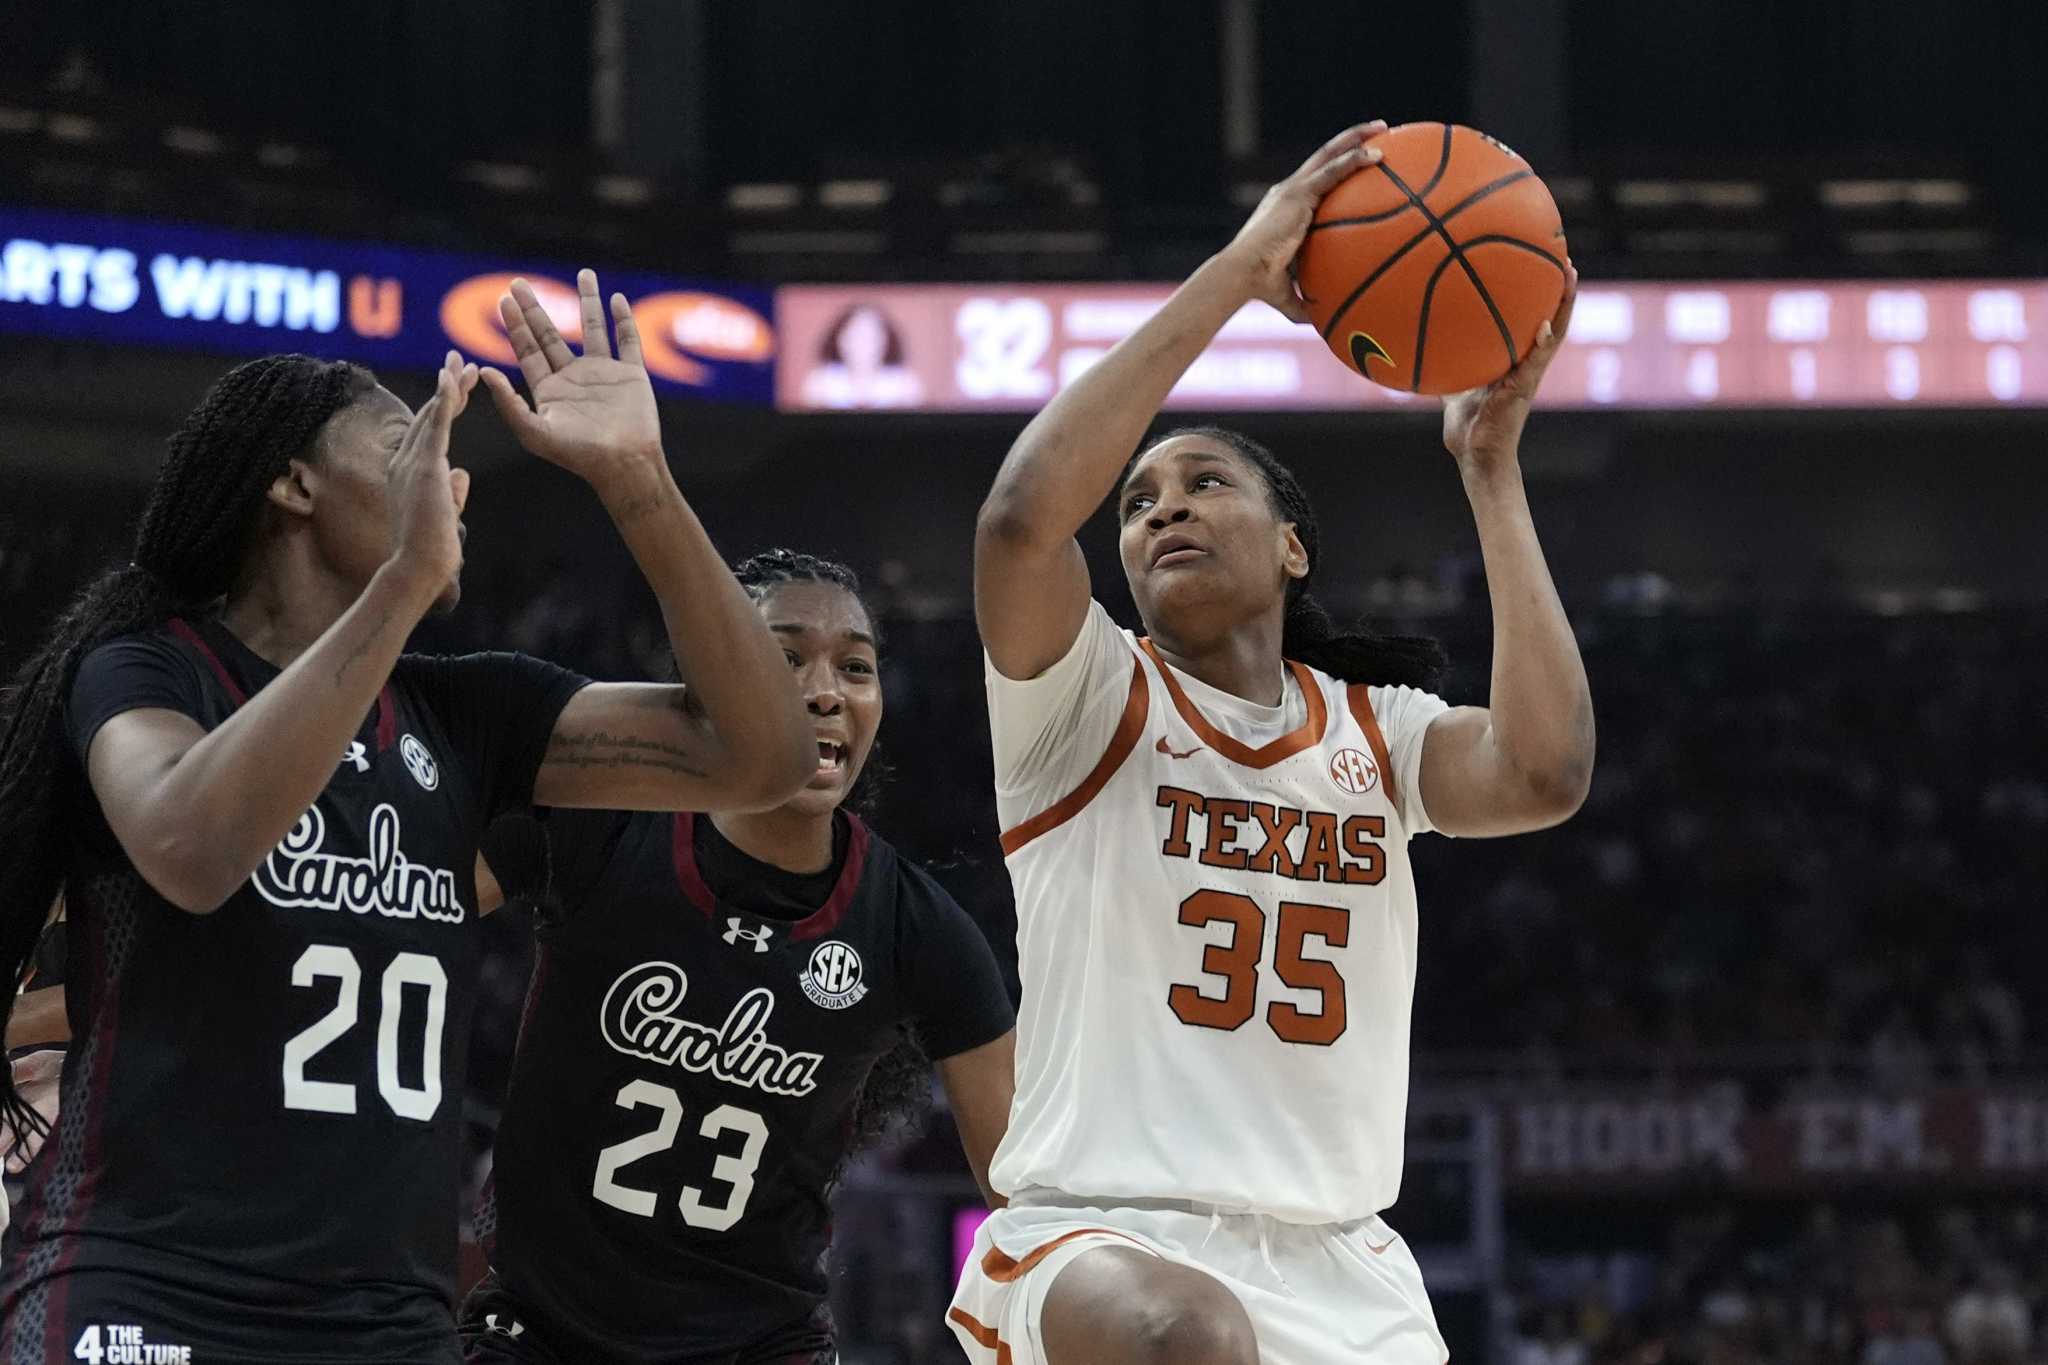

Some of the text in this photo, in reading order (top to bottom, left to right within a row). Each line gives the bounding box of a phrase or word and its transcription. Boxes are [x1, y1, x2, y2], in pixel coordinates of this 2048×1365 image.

[0, 239, 139, 313] RTS
[151, 254, 341, 332] WITH
[955, 297, 1053, 401] 32
[1331, 750, 1378, 793] SEC
[251, 803, 464, 923] Carolina
[1156, 786, 1386, 885] TEXAS
[803, 983, 858, 1009] GRADUATE
[813, 944, 858, 993] SEC
[1168, 888, 1350, 1046] 35
[283, 944, 448, 1121] 20
[601, 961, 824, 1097] Carolina
[593, 1079, 769, 1232] 23
[74, 1325, 143, 1365] 4 THE
[107, 1344, 191, 1365] CULTURE
